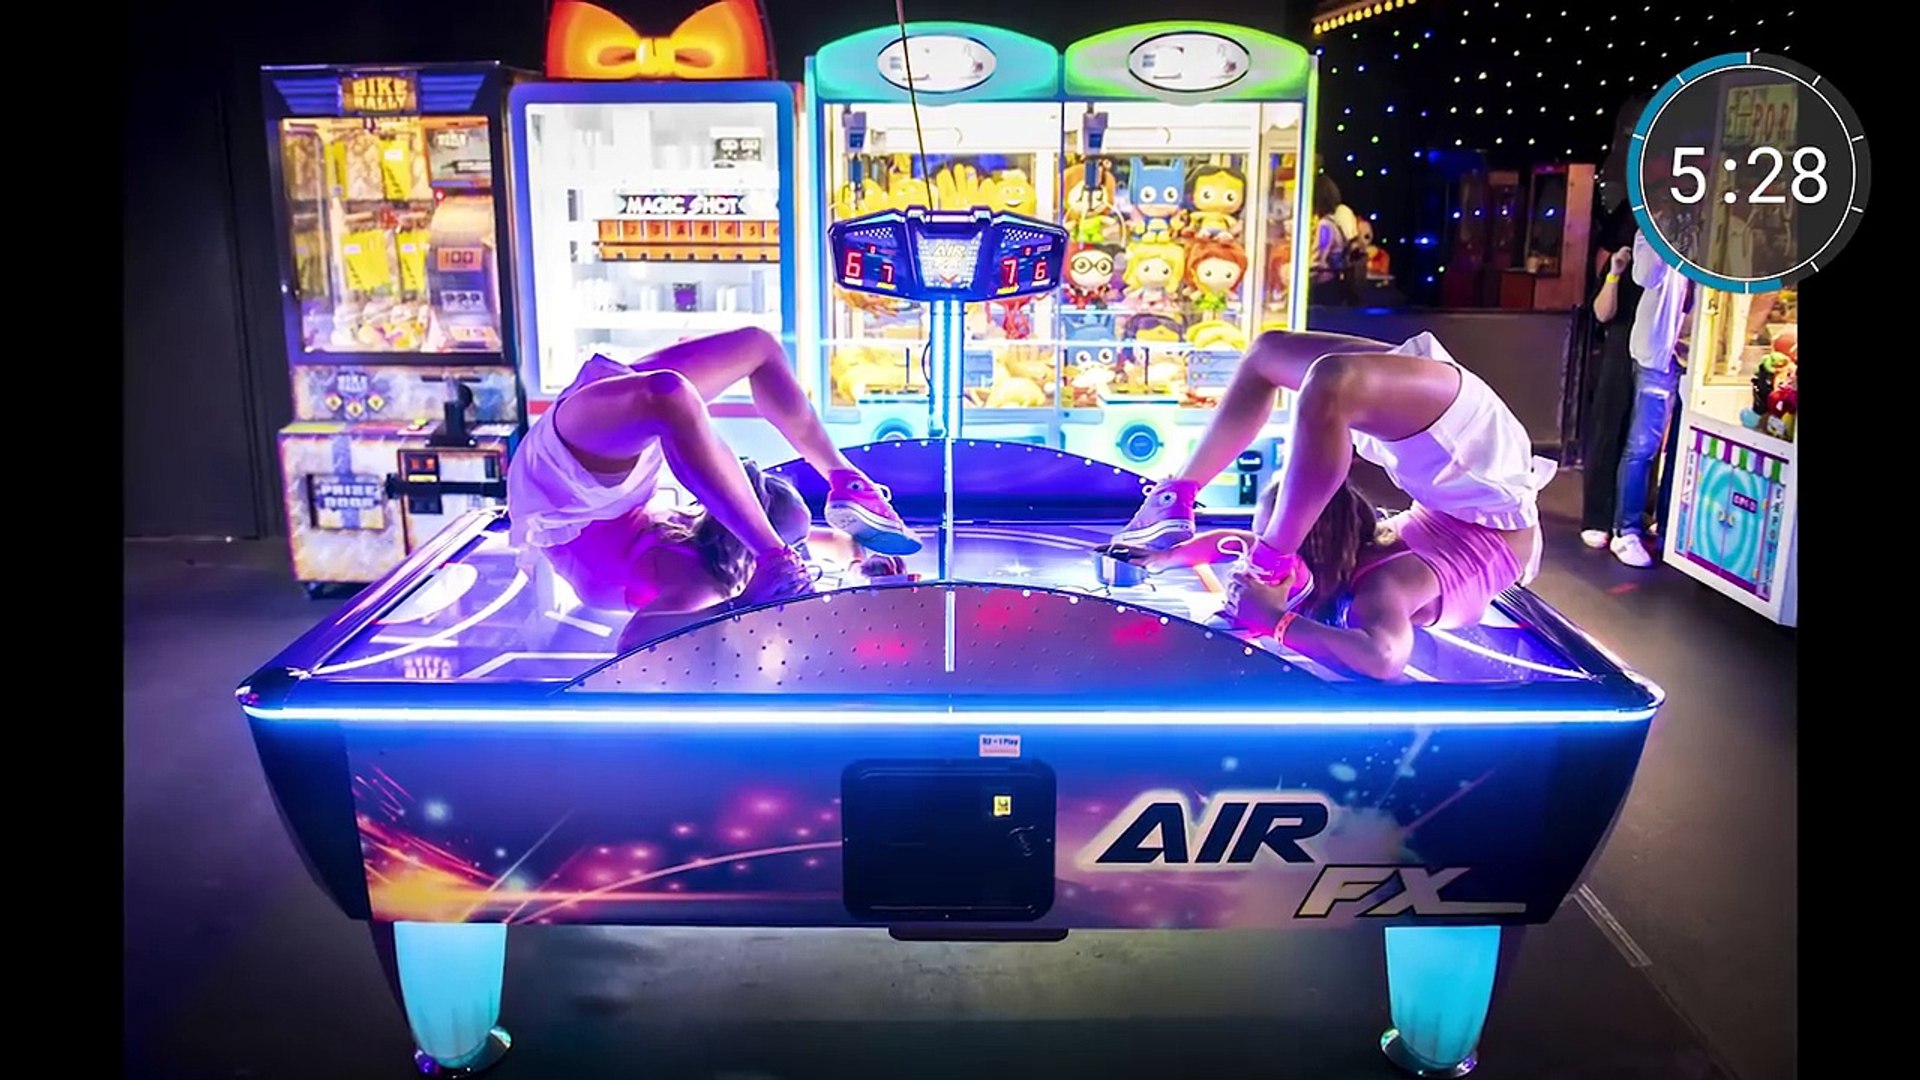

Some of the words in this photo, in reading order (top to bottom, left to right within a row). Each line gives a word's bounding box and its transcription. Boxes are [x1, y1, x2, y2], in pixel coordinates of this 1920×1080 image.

[353, 77, 407, 95] BIKE
[354, 96, 406, 111] RALLY
[626, 196, 685, 214] MAGIC
[687, 192, 740, 214] SHOT
[846, 252, 862, 277] 6
[883, 265, 893, 282] 7
[1003, 259, 1017, 284] 7
[1034, 262, 1047, 280] 6
[1095, 801, 1329, 864] AIR
[1294, 864, 1527, 918] FX
